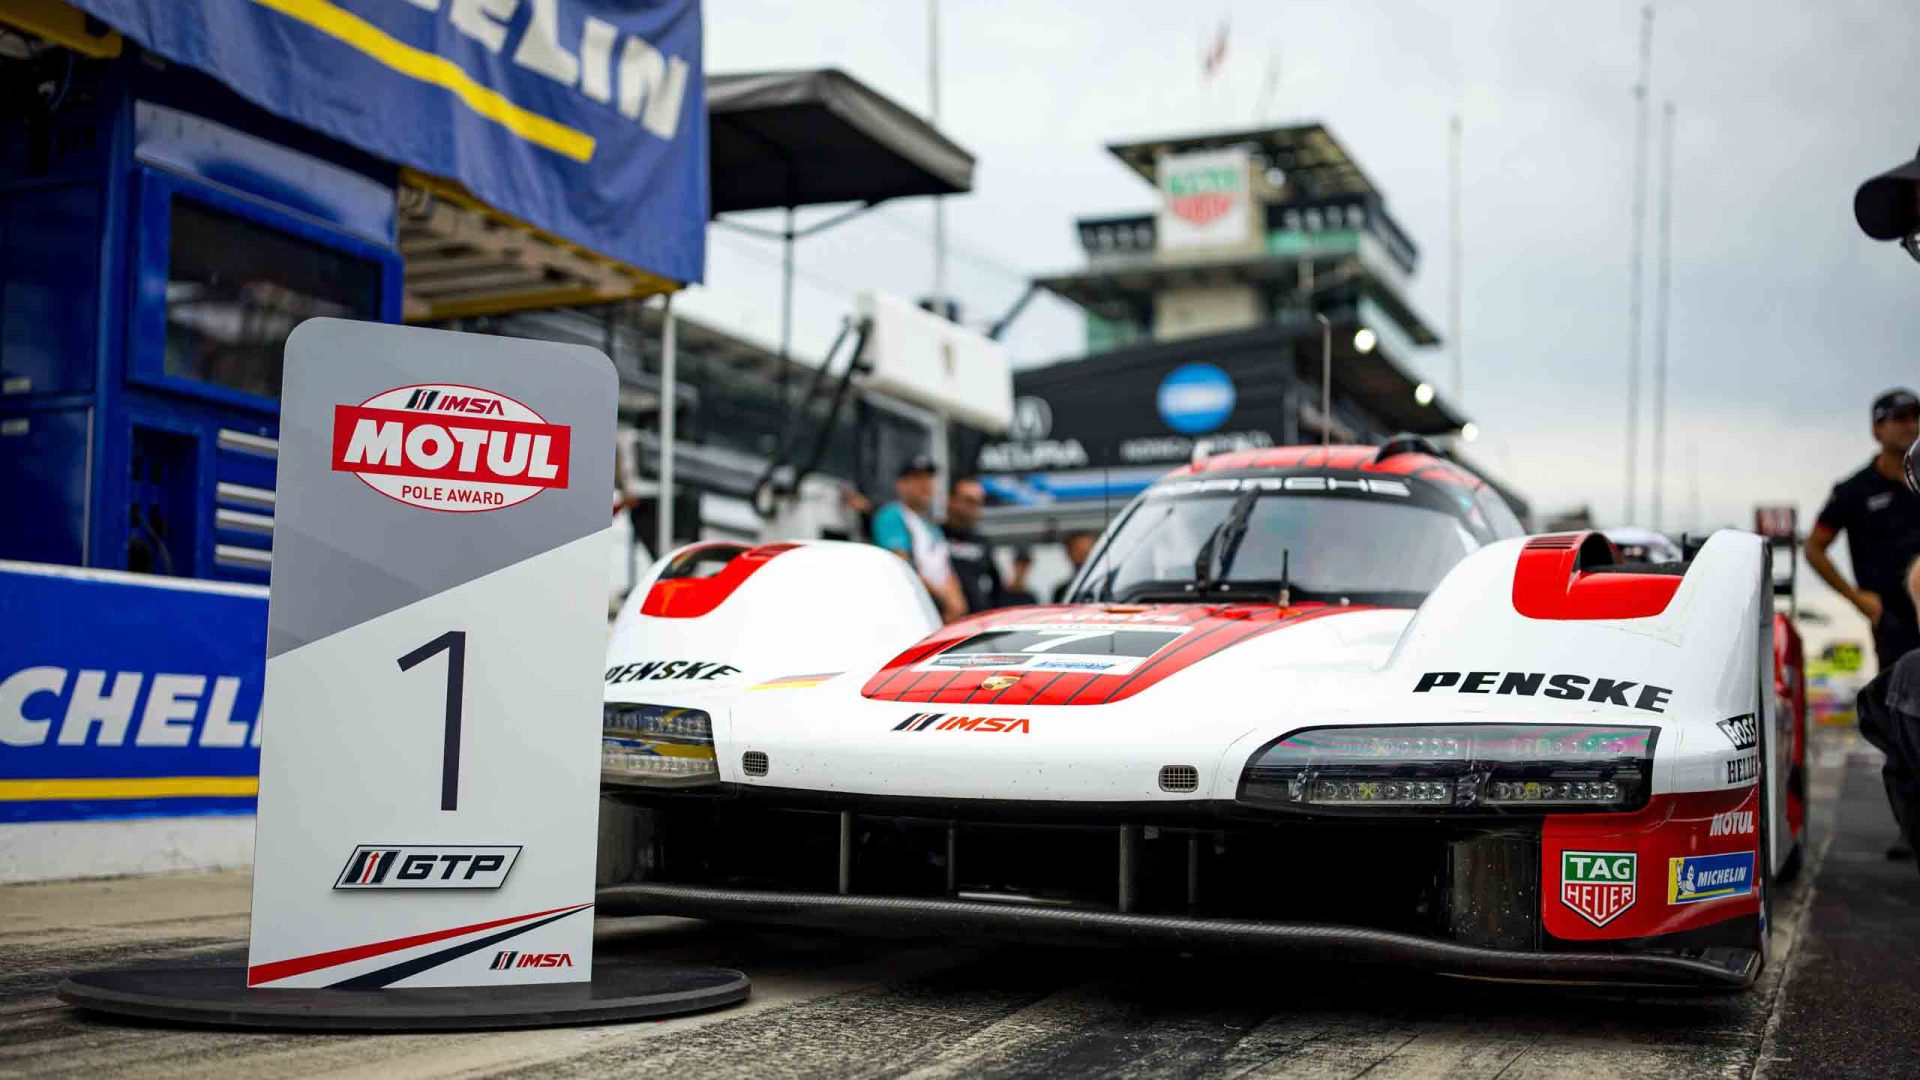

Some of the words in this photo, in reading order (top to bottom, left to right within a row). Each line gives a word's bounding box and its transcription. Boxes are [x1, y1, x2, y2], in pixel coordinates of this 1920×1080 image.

[437, 395, 505, 416] IMSA
[343, 418, 559, 480] MOTUL
[401, 485, 443, 501] POLE
[447, 489, 504, 505] AWARD
[1020, 629, 1117, 652] 7
[1412, 671, 1673, 713] PENSKE
[0, 666, 265, 748] CHEL
[396, 631, 466, 811] 1
[936, 716, 1030, 733] IMSA
[1721, 717, 1756, 747] BOSS
[1709, 811, 1754, 836] MOTUL
[397, 855, 505, 880] GTP
[1569, 857, 1631, 880] TAG
[1697, 866, 1747, 888] MICHELIN
[1567, 885, 1631, 920] HEUER
[516, 953, 574, 968] IMSA
